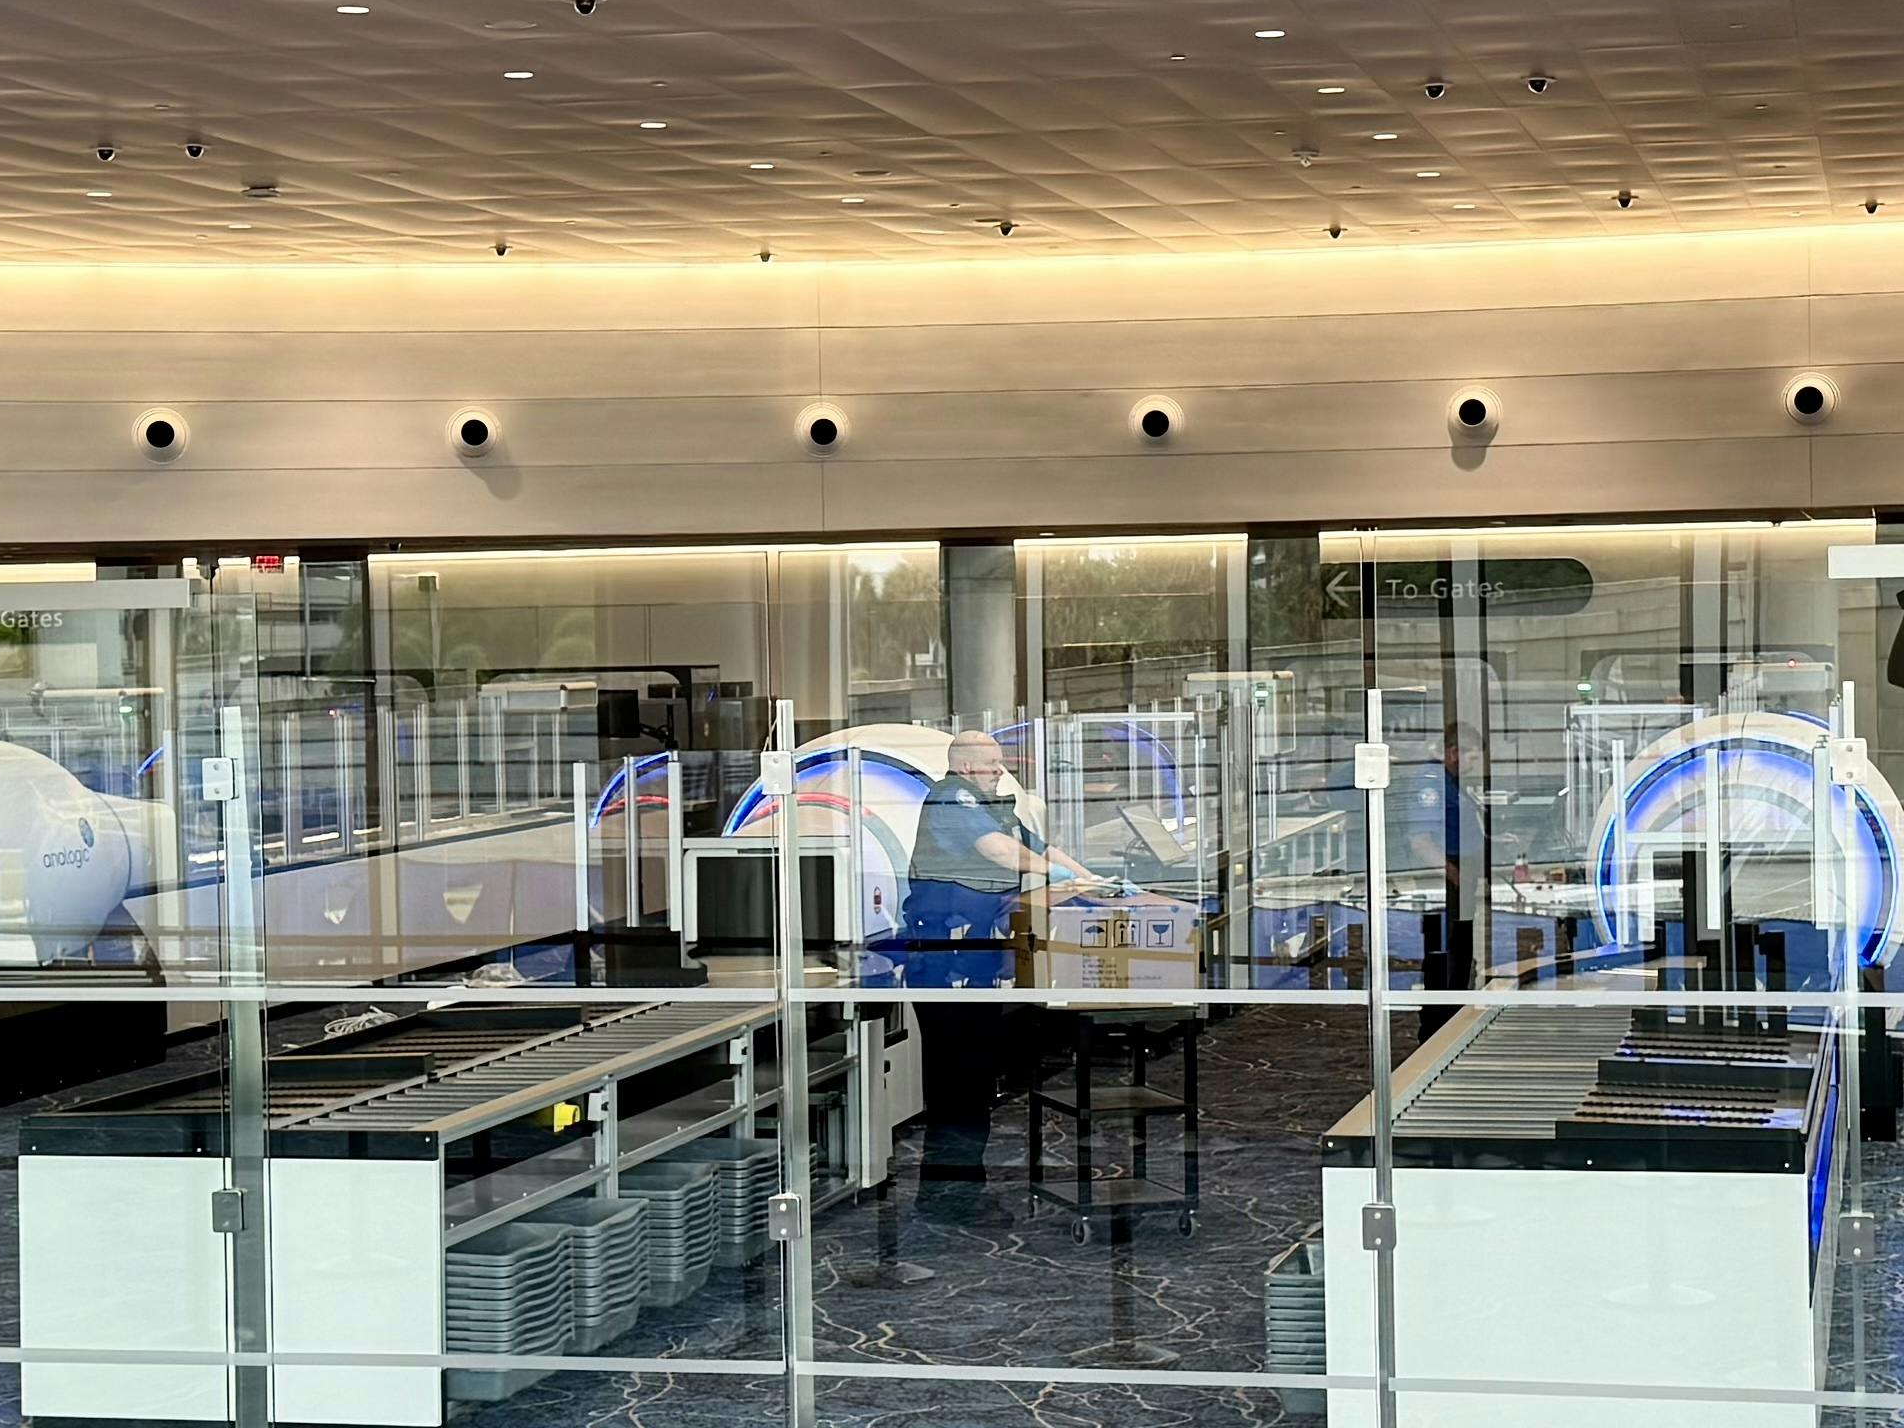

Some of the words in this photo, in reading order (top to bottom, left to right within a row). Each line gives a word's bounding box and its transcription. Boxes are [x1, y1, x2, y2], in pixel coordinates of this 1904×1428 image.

[1385, 578, 1418, 599] To
[1430, 577, 1505, 599] Gates
[0, 609, 64, 629] Gates
[42, 846, 90, 869] analogc
